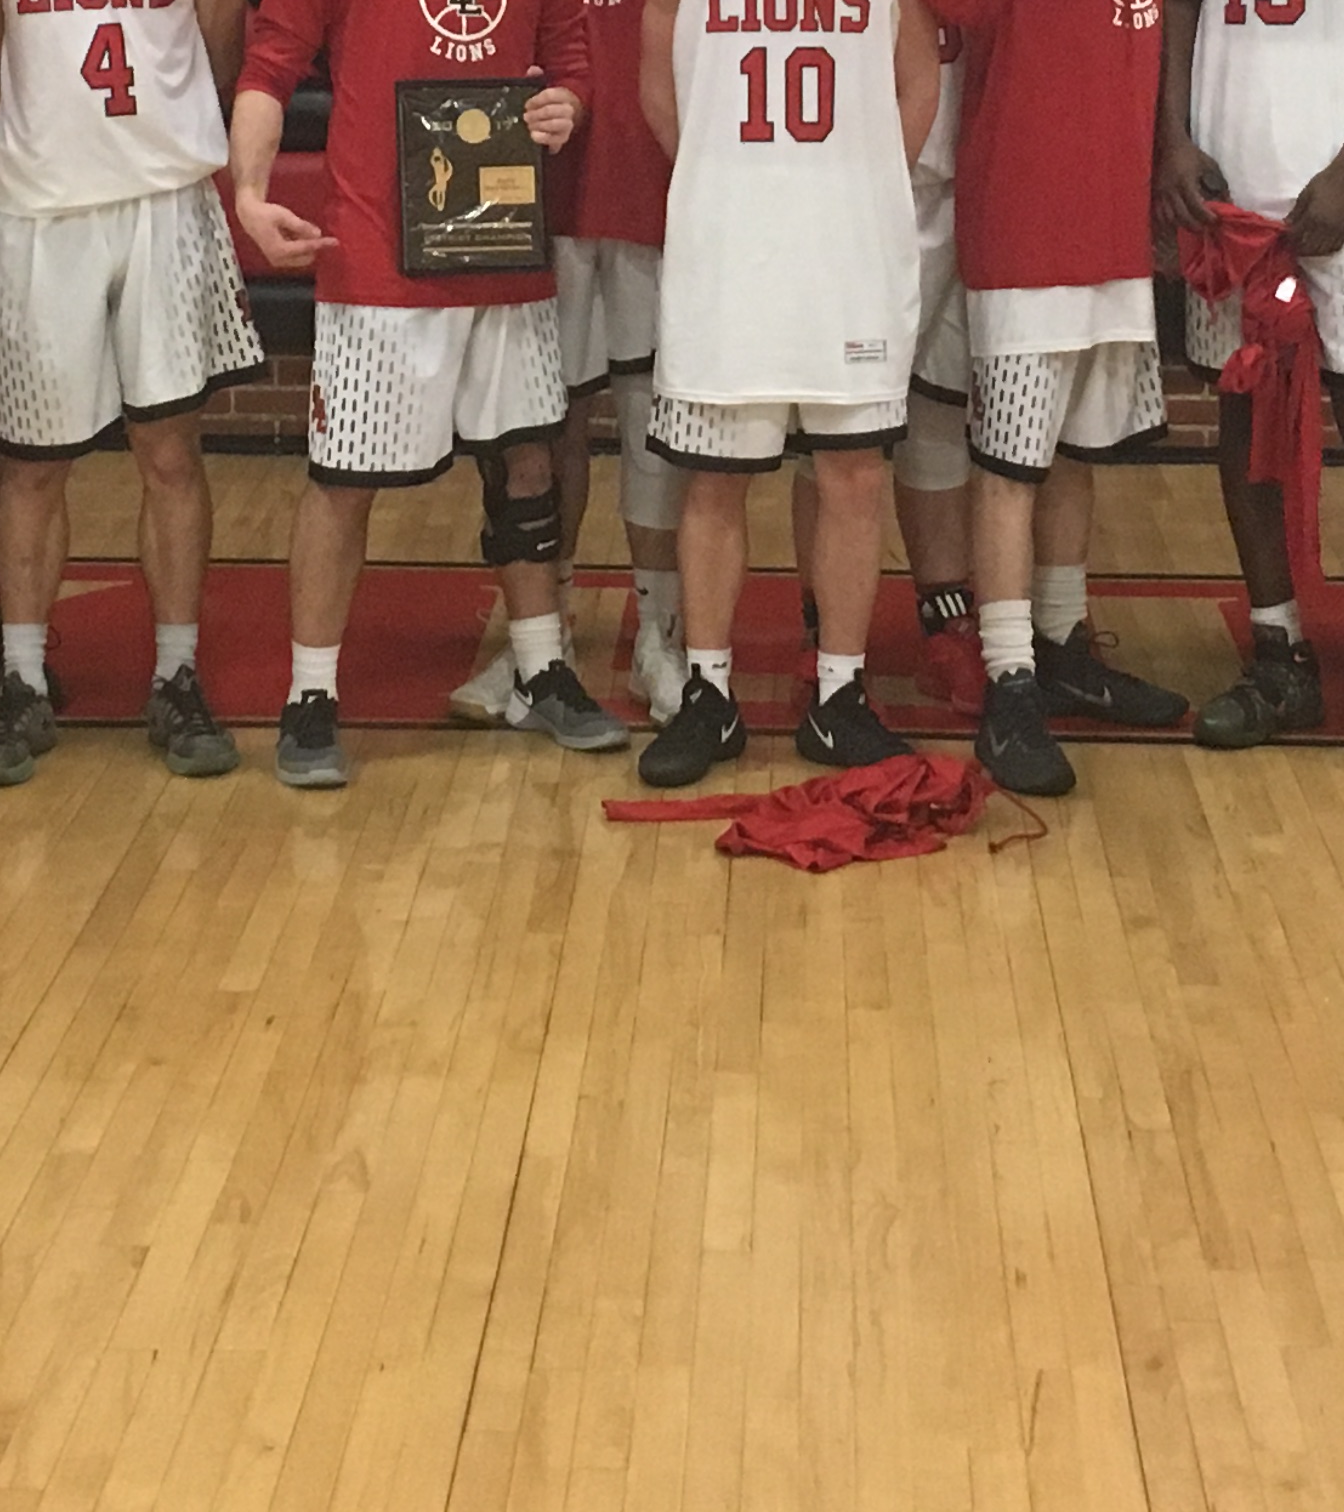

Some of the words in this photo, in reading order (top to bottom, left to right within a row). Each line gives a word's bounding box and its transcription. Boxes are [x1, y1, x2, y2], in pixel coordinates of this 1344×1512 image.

[1112, 4, 1159, 29] LONS
[81, 23, 137, 117] 4
[429, 35, 496, 63] LIONS
[740, 46, 835, 142] 10
